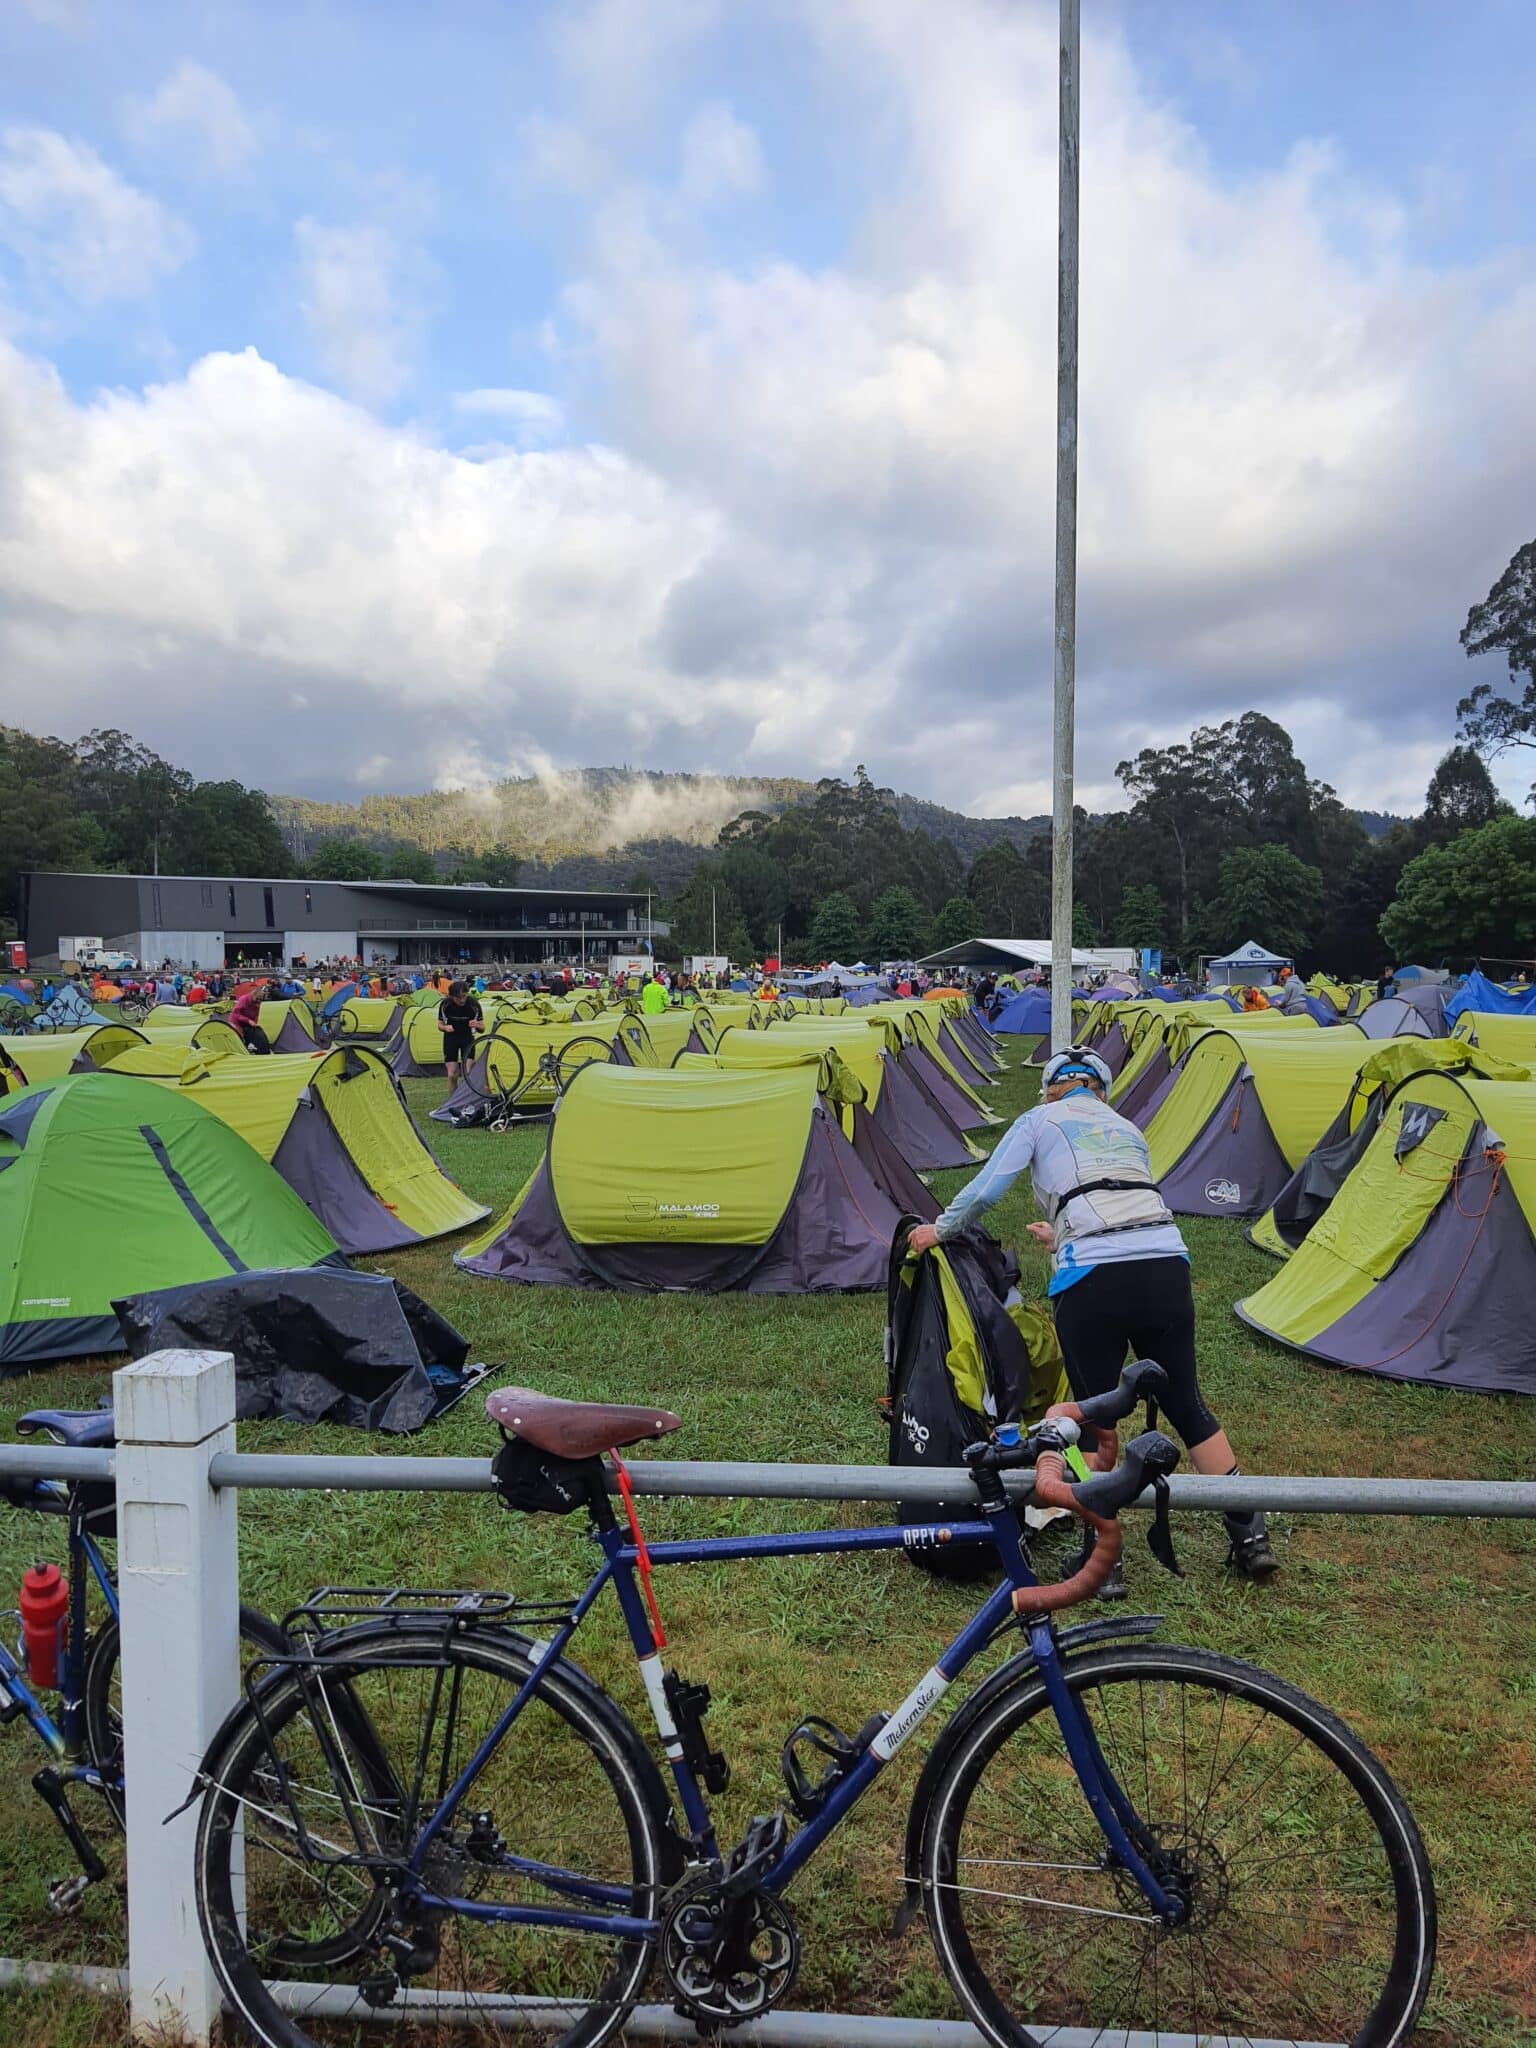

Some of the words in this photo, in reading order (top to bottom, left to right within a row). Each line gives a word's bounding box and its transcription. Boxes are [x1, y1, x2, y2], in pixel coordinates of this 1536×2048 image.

[659, 1203, 720, 1211] MALAMOO
[903, 1527, 936, 1545] OPPY
[883, 1708, 921, 1749] Malvern
[917, 1687, 937, 1711] Star
